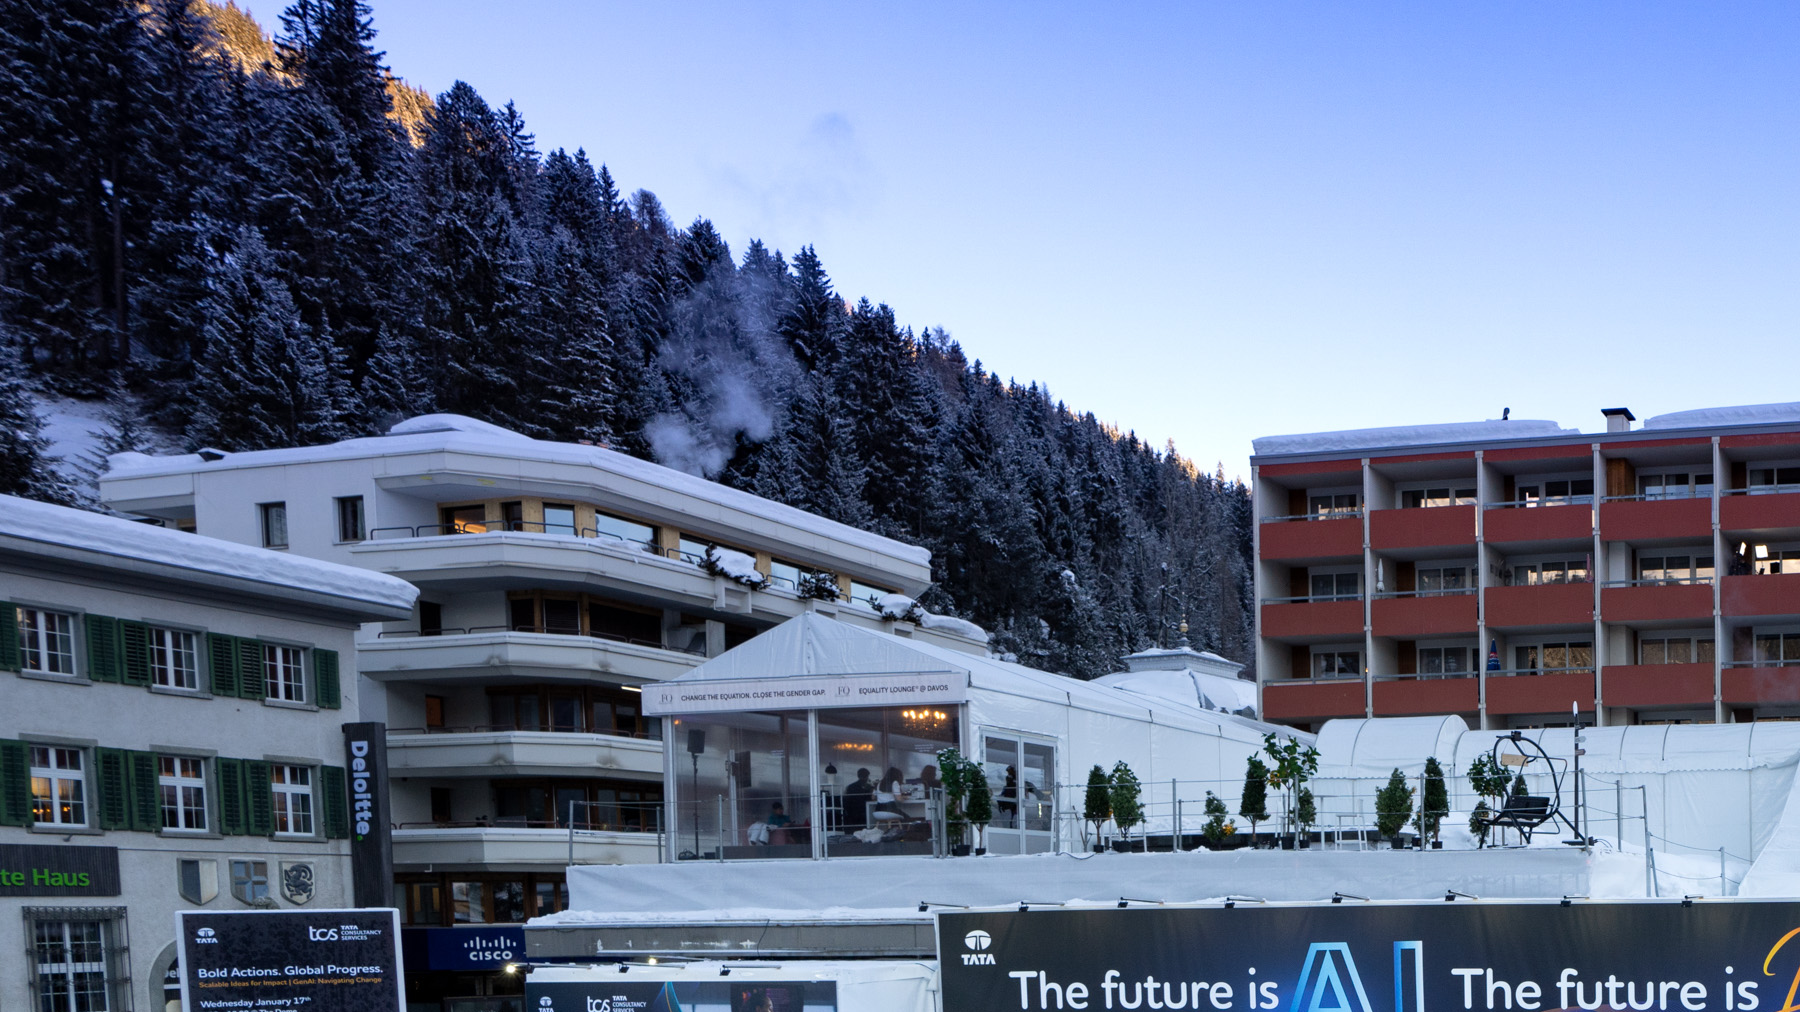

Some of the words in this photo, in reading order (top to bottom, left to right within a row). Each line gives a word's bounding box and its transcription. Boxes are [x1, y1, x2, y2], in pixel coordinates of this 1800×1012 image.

[859, 687, 888, 695] EQUALITY
[919, 685, 926, 693] @
[927, 684, 949, 692] DAVOS
[681, 694, 706, 702] CHANGE
[707, 693, 718, 701] THE
[720, 692, 751, 701] EQUATION.
[752, 691, 773, 699] CLOSE
[773, 690, 785, 698] THE
[32, 868, 91, 887] Haus
[308, 925, 338, 942] tcs
[469, 951, 513, 961] CISCO
[961, 953, 996, 966] TATA
[198, 968, 228, 979] Bold
[231, 966, 282, 977] Actions.
[284, 965, 324, 976] Global
[327, 964, 383, 976] Progress.
[263, 978, 288, 988] Impact
[318, 976, 355, 986] Navigating
[355, 976, 382, 985] Change
[1008, 970, 1089, 1010] The
[1101, 969, 1234, 1010] future
[1248, 966, 1280, 1010] is
[1451, 967, 1542, 1010] The
[1556, 966, 1707, 1011] future
[1725, 965, 1759, 1011] is
[200, 999, 254, 1010] Wednesday
[255, 998, 292, 1008] January
